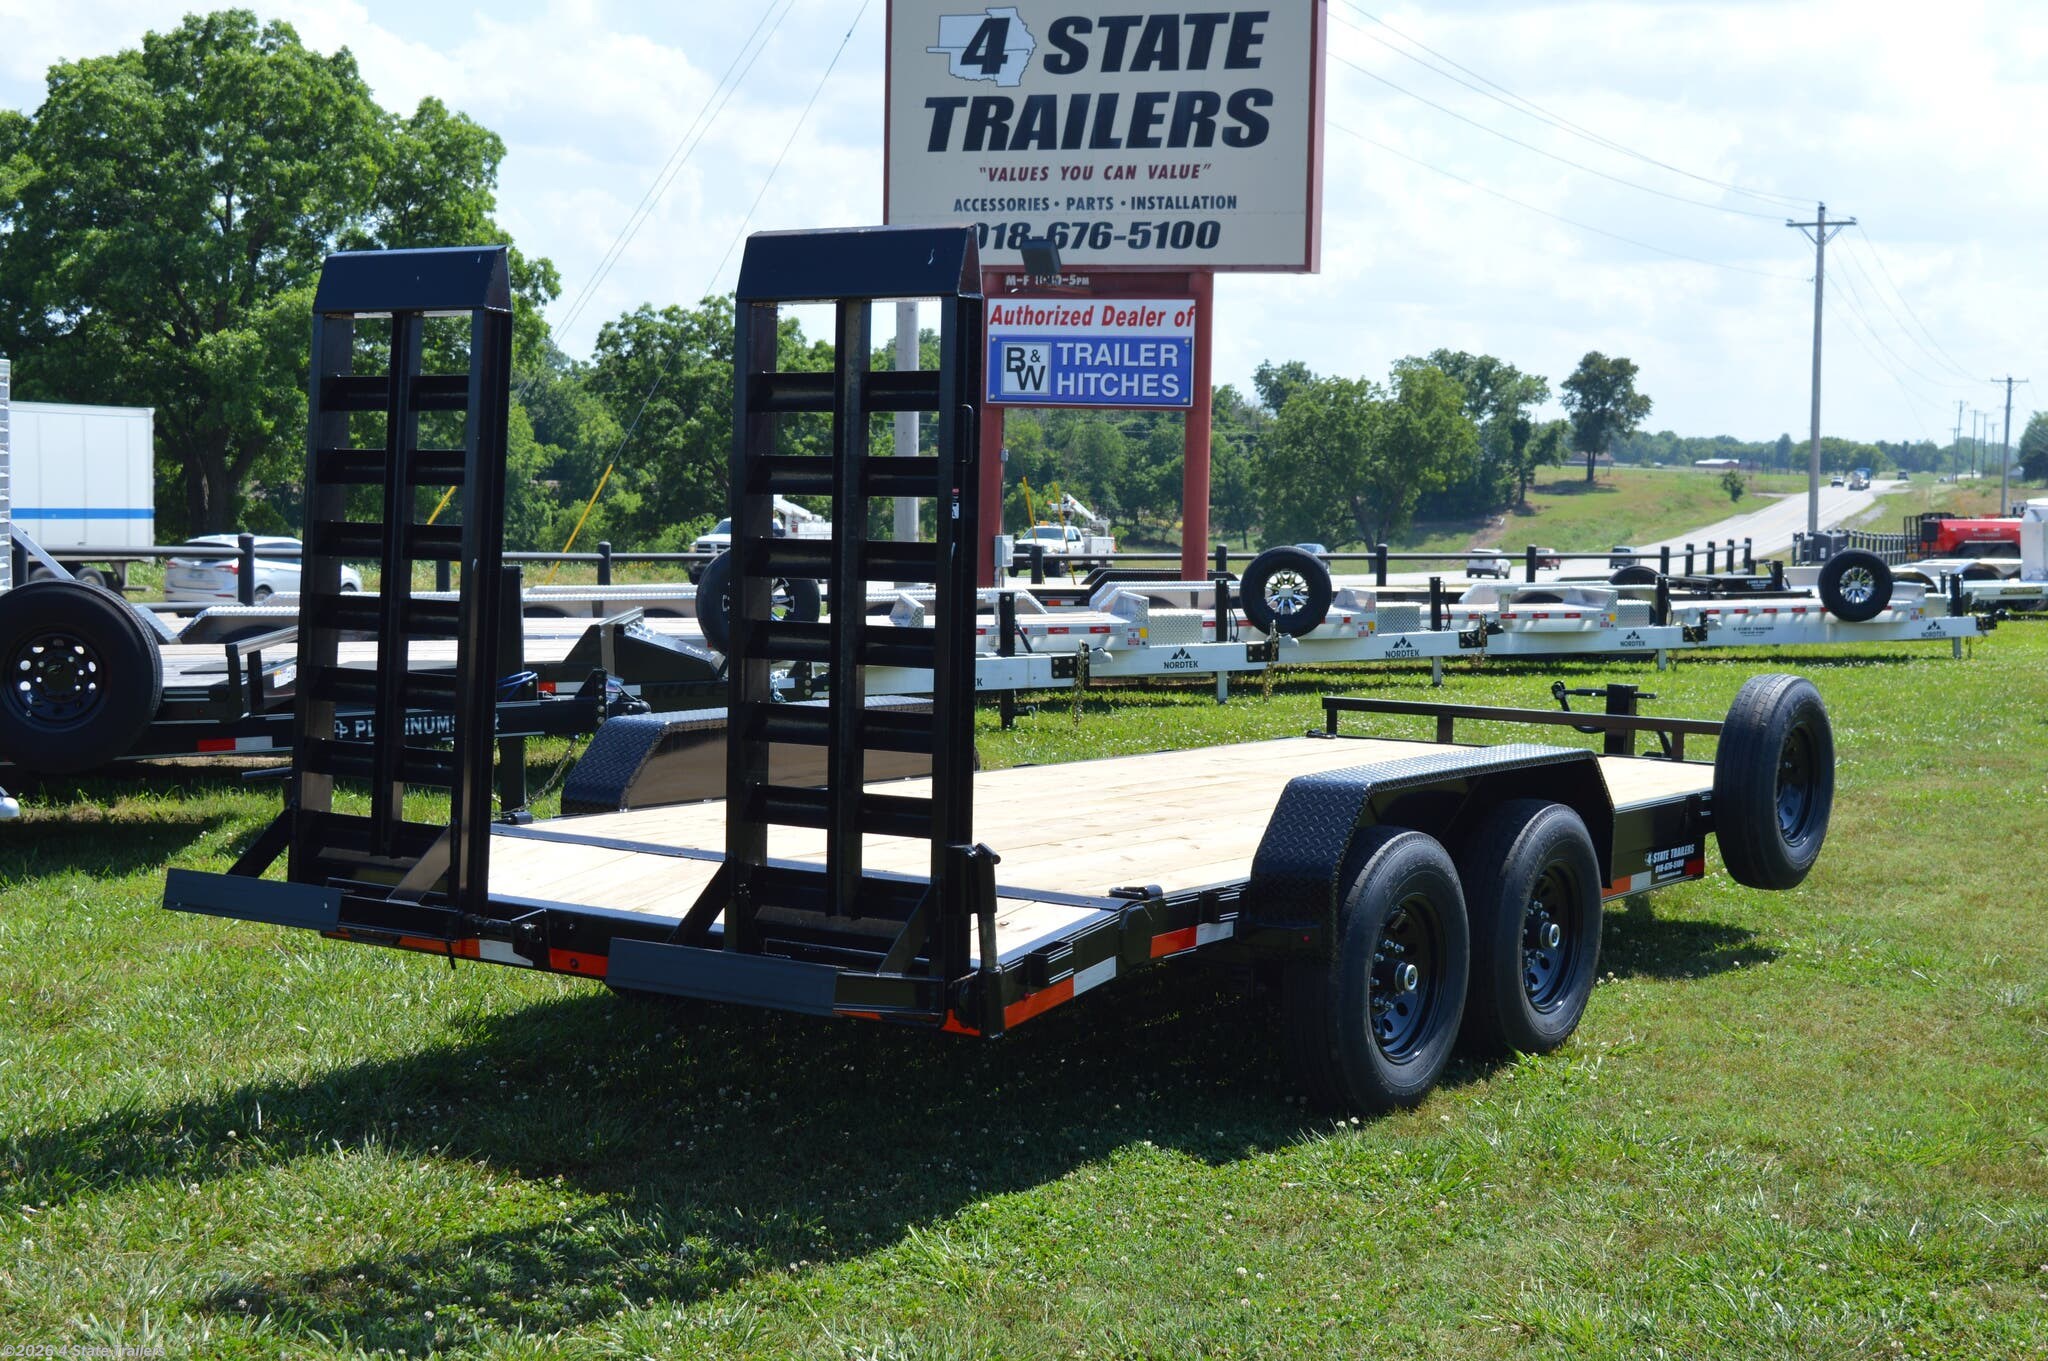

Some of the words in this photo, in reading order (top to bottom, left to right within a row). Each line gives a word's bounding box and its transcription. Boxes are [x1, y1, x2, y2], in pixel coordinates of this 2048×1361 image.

[960, 17, 1011, 75] 4
[1043, 10, 1270, 75] STATE
[924, 88, 1273, 153] TRAILERS
[1060, 165, 1093, 182] YOU
[1103, 165, 1136, 181] CAN
[953, 197, 1050, 213] ACCESSORIES
[1066, 196, 1114, 212] PARTS
[1130, 195, 1238, 211] INSTALLATION
[989, 304, 1095, 326] Authorized
[1101, 305, 1166, 327] Dealer
[1174, 305, 1196, 328] of
[1056, 343, 1178, 367] TRAILER
[1057, 372, 1180, 397] HITCHES
[1164, 660, 1199, 669] NORDTEK
[1385, 649, 1420, 658] NORDTEK
[355, 715, 450, 738] PLINUM
